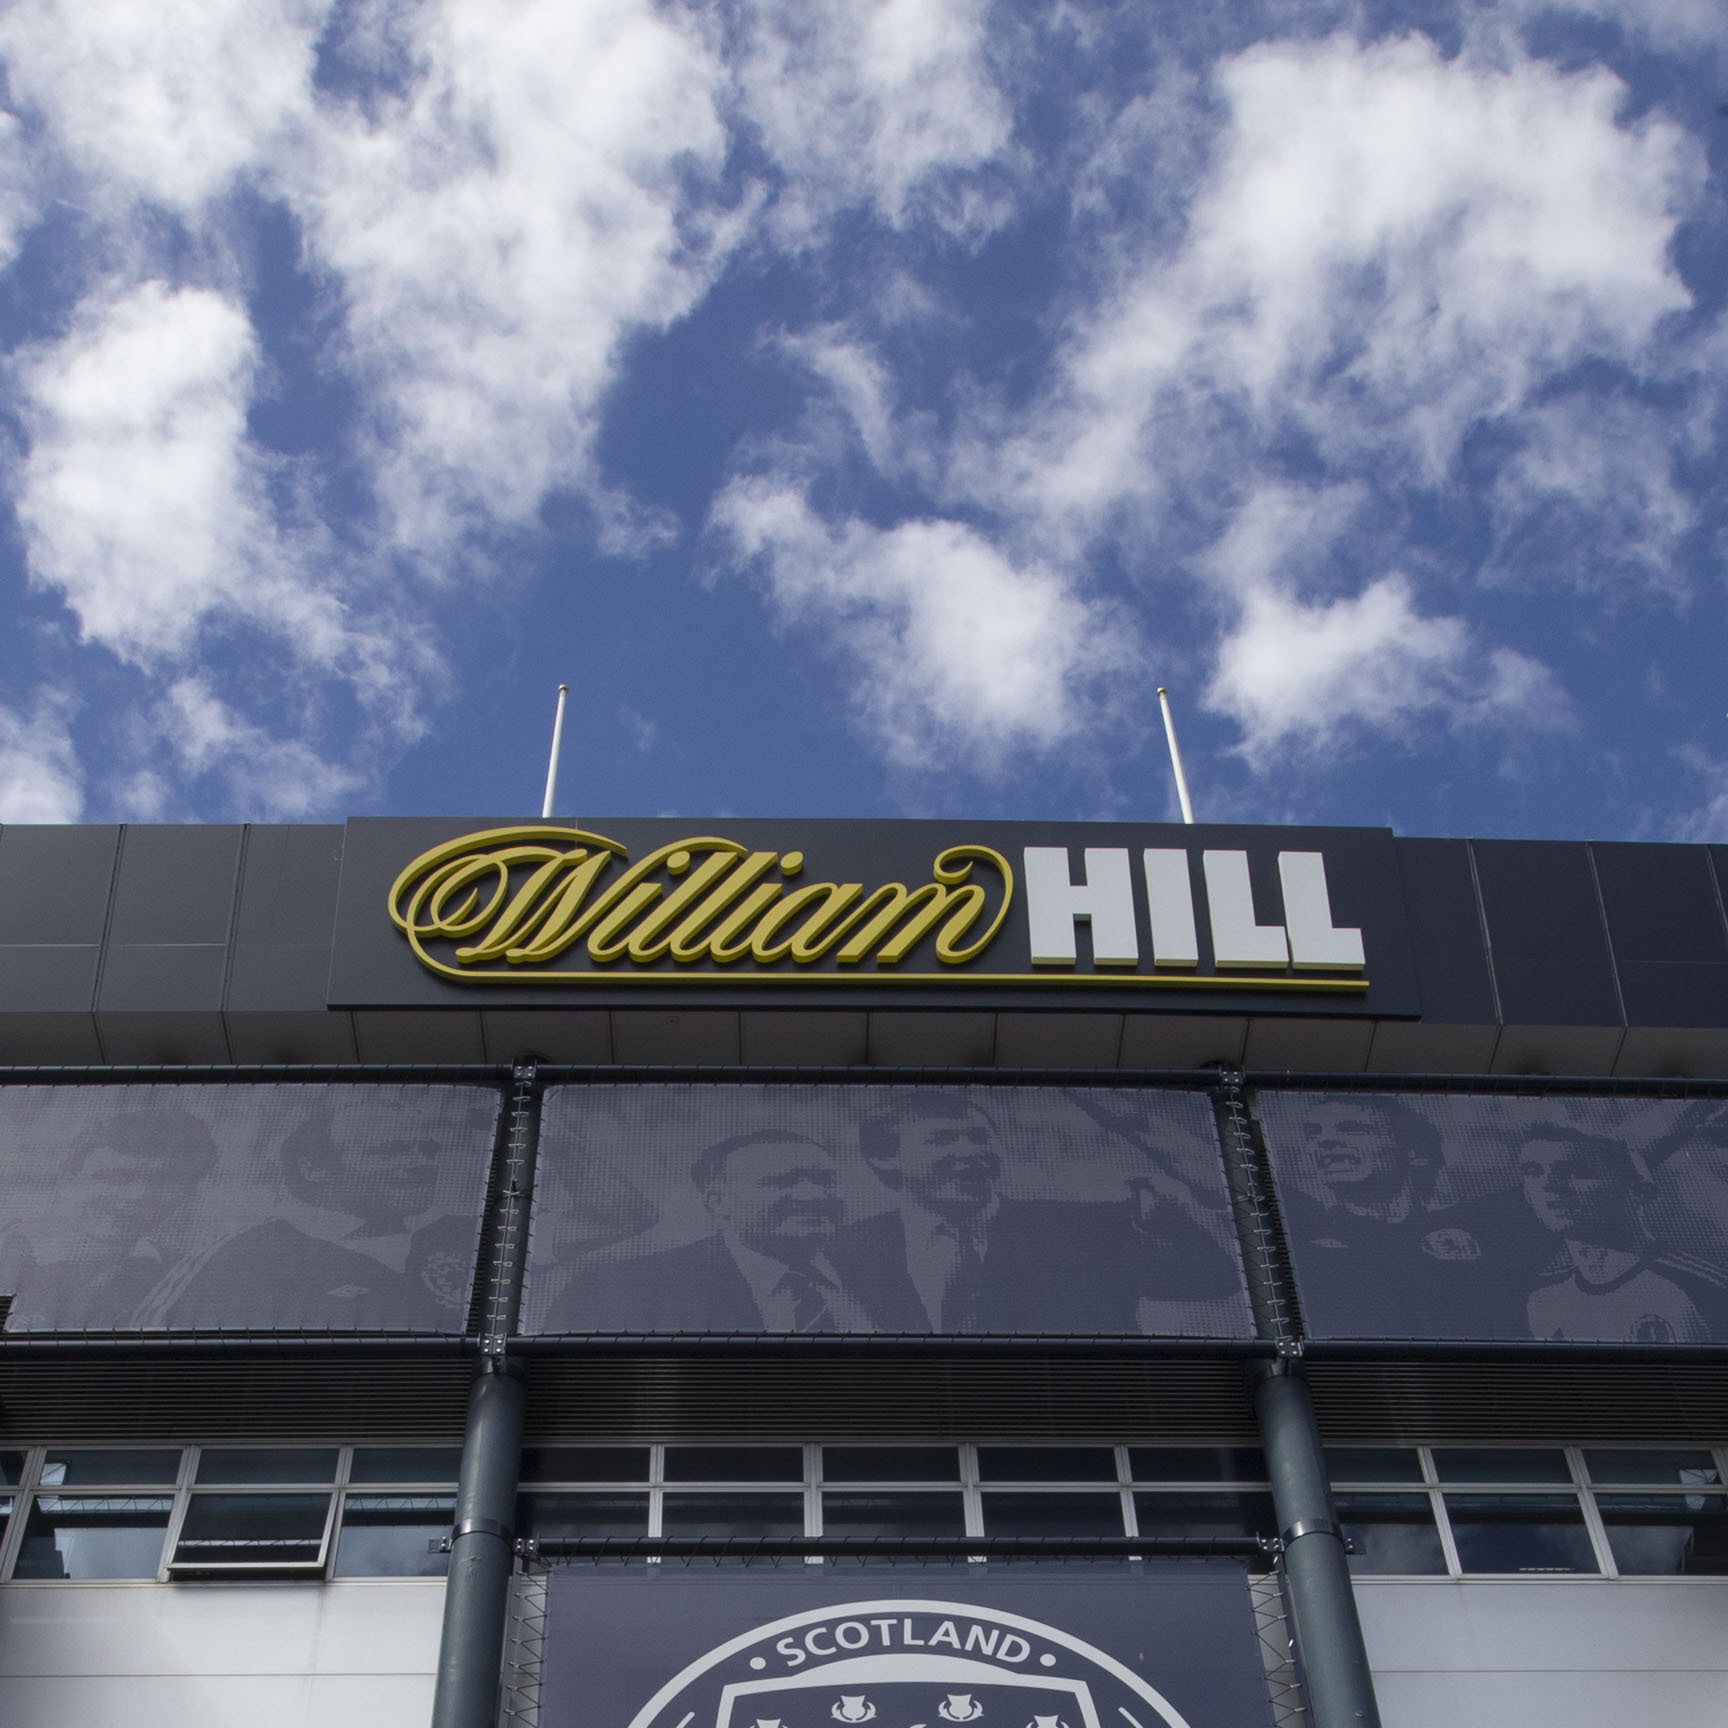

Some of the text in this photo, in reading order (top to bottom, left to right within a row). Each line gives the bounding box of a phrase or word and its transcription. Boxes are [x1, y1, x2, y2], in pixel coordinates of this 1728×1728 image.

[387, 824, 1366, 978] William HILL
[775, 1617, 1032, 1668] SCOTLAND
